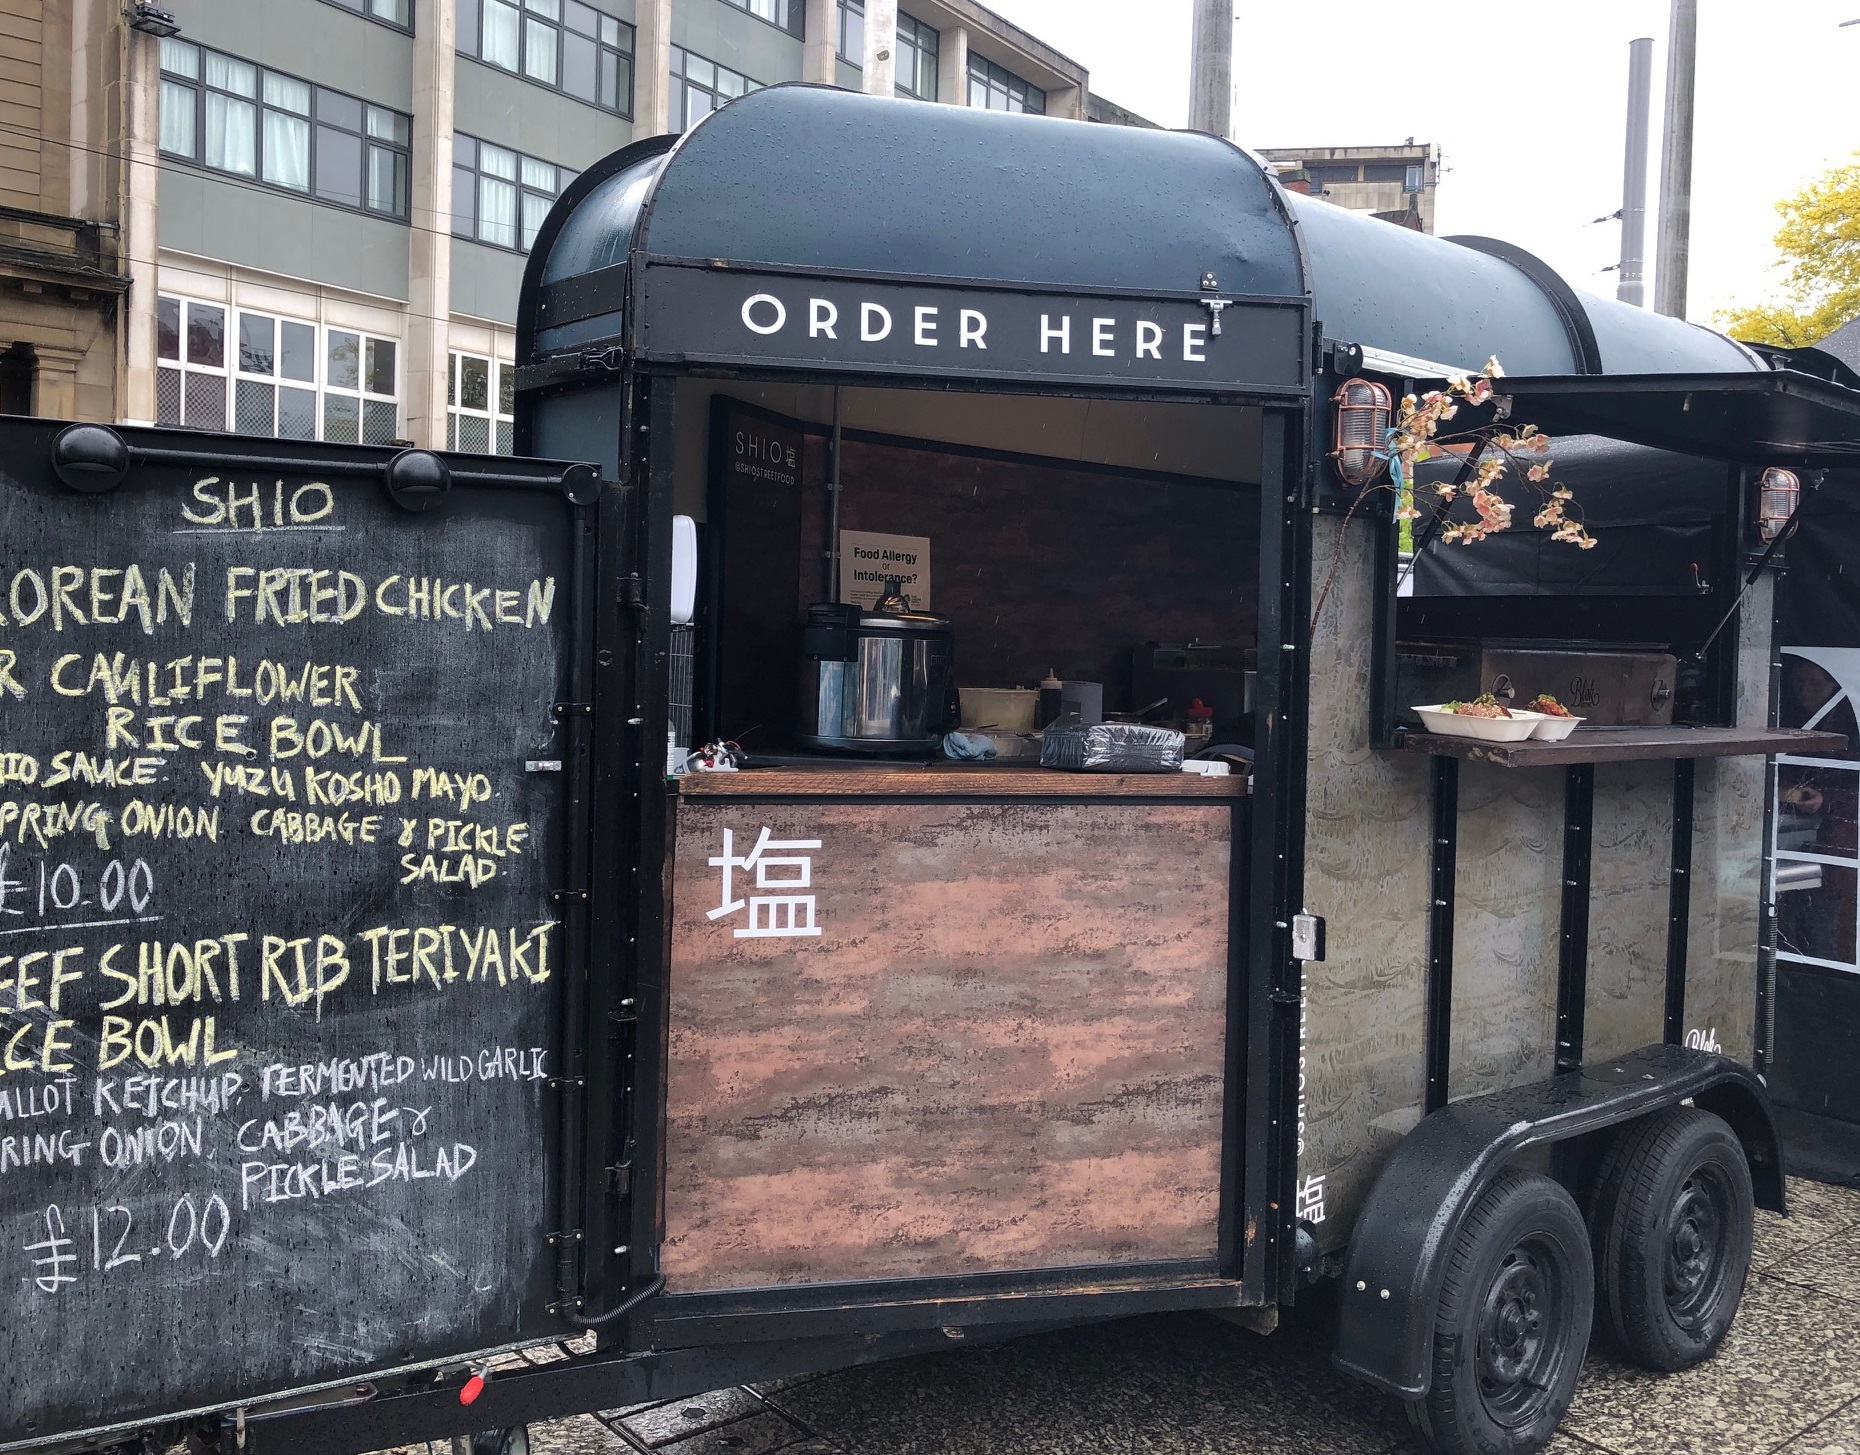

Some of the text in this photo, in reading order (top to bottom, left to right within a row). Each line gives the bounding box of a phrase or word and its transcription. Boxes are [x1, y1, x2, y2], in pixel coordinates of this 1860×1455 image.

[741, 293, 1206, 362] ORDER HERE
[735, 431, 782, 463] SHIO
[735, 461, 795, 486] @SHIOSTREETFOOD
[181, 476, 335, 533] SHIO
[853, 569, 918, 584] Intolerance?
[854, 547, 917, 565] Food Allergy
[0, 562, 555, 635] OREAN FRIED CHICKEN
[50, 651, 362, 713] CAULIFLOWER
[106, 707, 408, 764] RICE BOWL
[0, 753, 39, 785] IO
[305, 766, 401, 806] KOSHO
[250, 806, 384, 845] CABBAGE
[427, 818, 529, 857] PICKLE
[705, 826, 822, 938] 塩
[99, 933, 248, 1011] SHORT
[262, 934, 350, 1023] RIB
[356, 921, 556, 994] TERIYAKI
[0, 1015, 237, 1076] CE BOWL
[262, 1052, 416, 1102] FERMENTED
[421, 1055, 473, 1082] WILD
[478, 1046, 548, 1081] GARLIC
[237, 1097, 399, 1153] CABBAGE
[242, 1142, 477, 1211] PICKLE SALAD
[22, 1190, 230, 1293] £12.00
